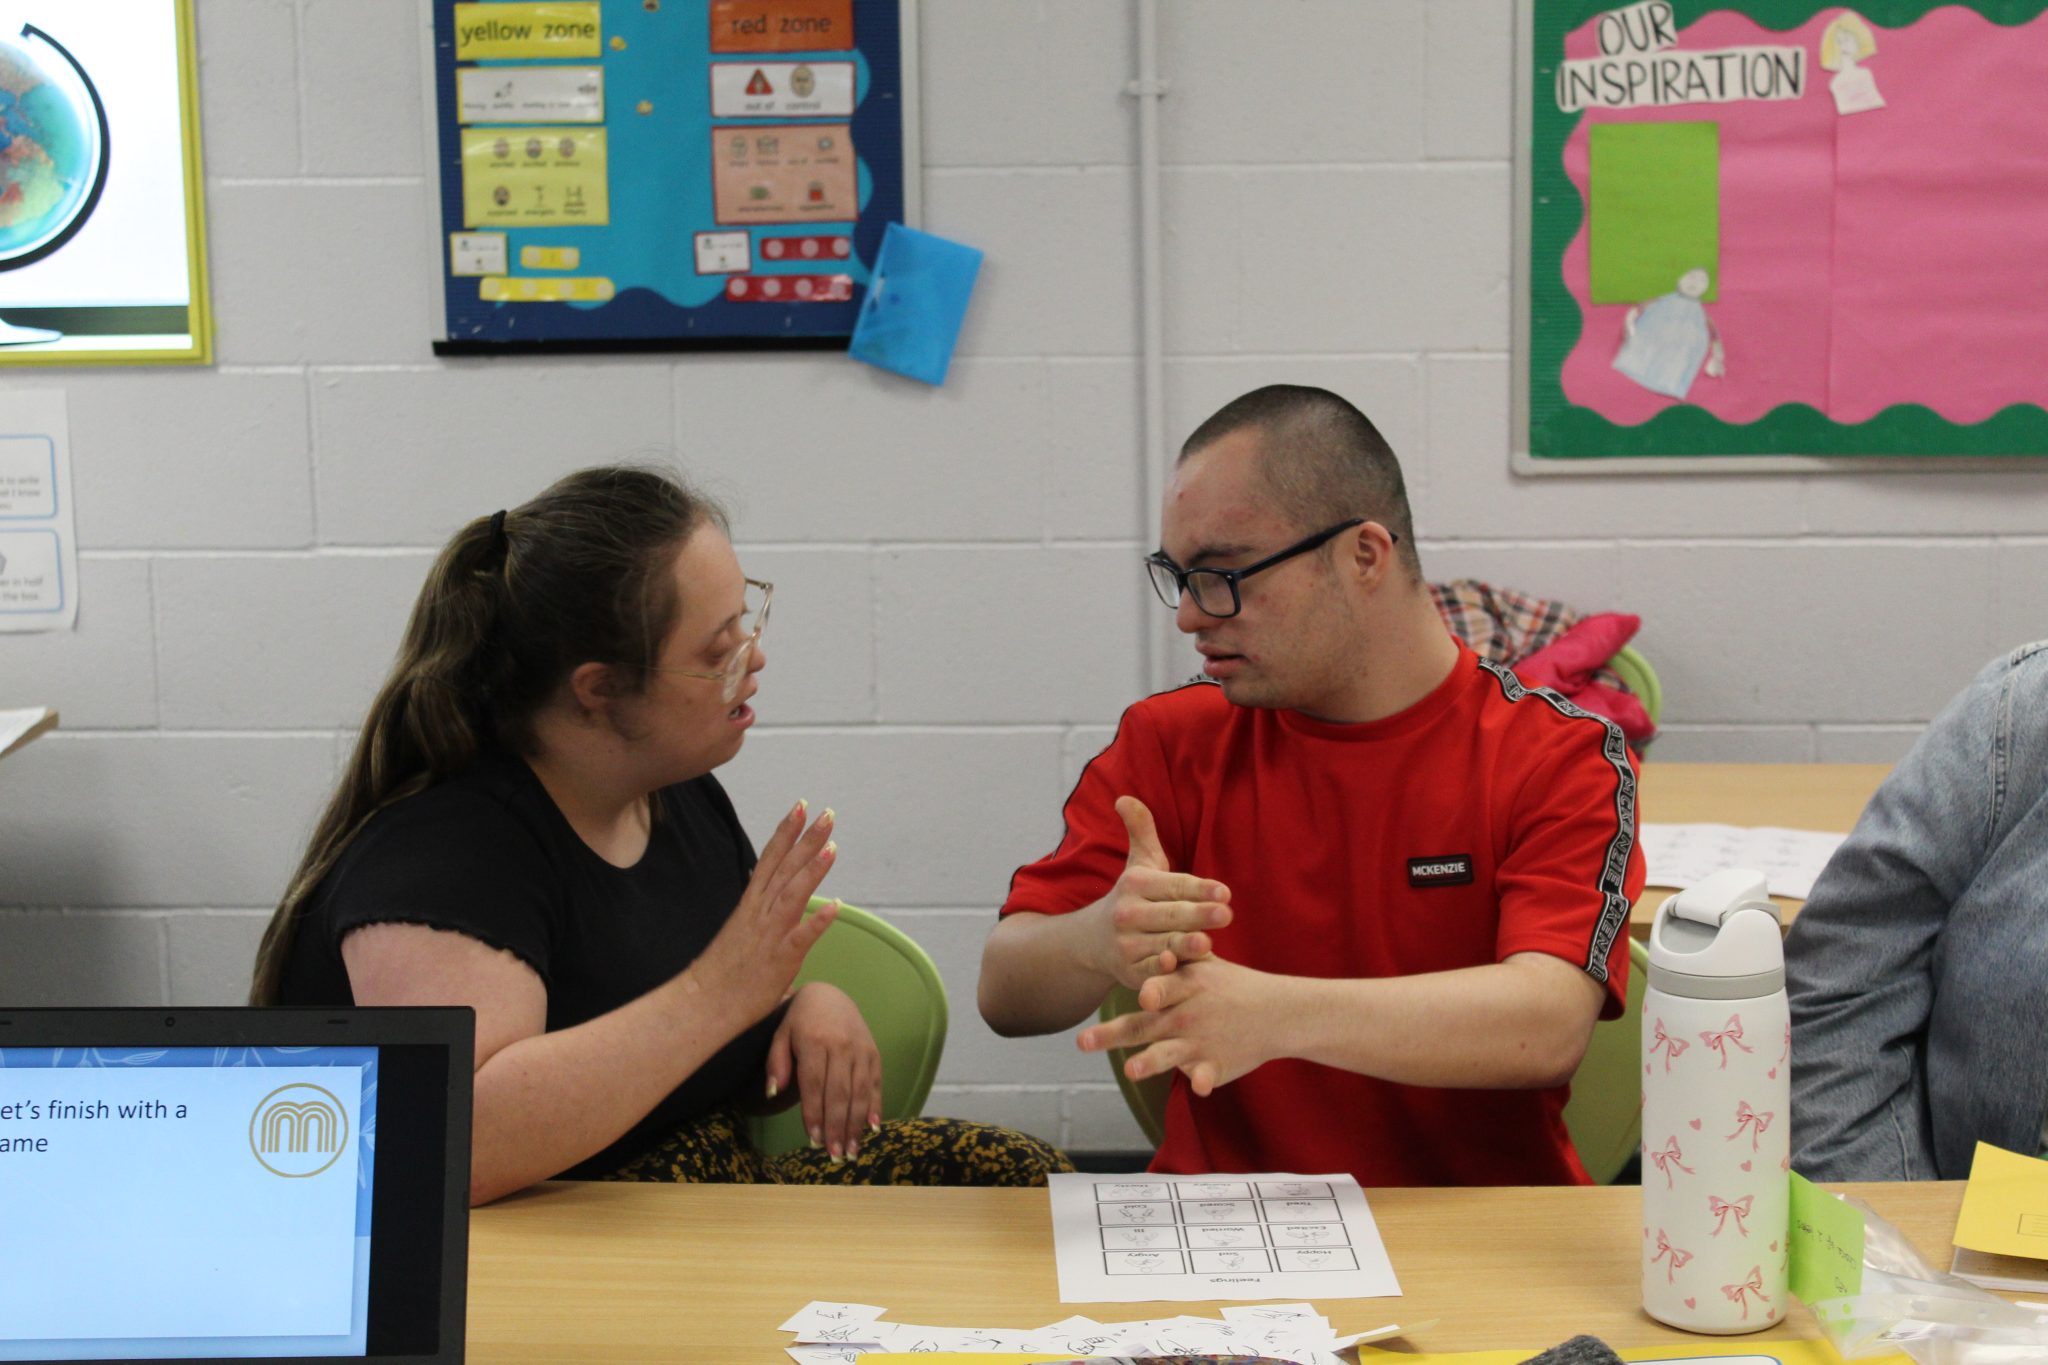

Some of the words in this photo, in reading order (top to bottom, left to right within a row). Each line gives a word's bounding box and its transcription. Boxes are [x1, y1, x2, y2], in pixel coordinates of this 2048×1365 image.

[461, 21, 532, 47] yellow
[543, 22, 596, 39] zone
[732, 14, 767, 33] red
[780, 17, 832, 33] zone
[1599, 3, 1677, 56] OUR
[1558, 51, 1801, 107] INSPIRATION
[1411, 862, 1467, 877] MCKENZIE
[1591, 895, 1625, 982] CKENZIE
[0, 1099, 41, 1120] et’s
[48, 1099, 109, 1119] finish
[117, 1099, 168, 1119] with
[175, 1104, 188, 1119] a
[0, 1137, 49, 1153] ame
